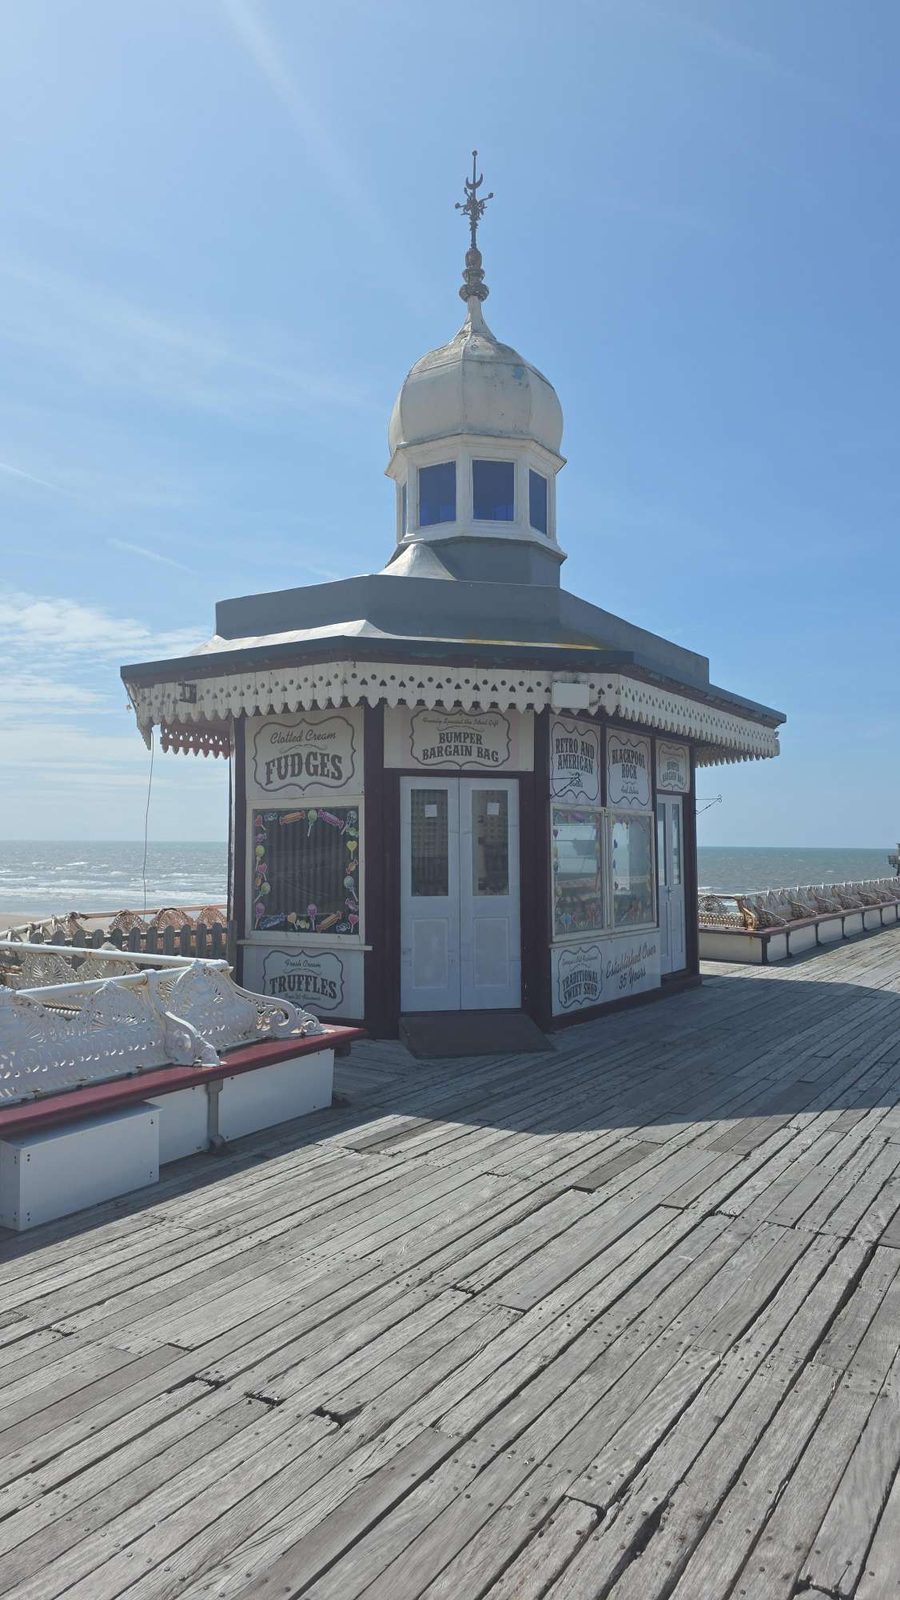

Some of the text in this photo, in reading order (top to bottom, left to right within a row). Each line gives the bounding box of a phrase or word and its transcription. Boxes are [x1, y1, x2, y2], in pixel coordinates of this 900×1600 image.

[270, 729, 336, 744] Clotted Cream
[439, 732, 483, 745] BUMPER
[422, 745, 499, 762] BARGAIN BAG
[556, 738, 594, 760] RETRO AND
[611, 748, 646, 769] BLACKPOOL
[265, 751, 343, 786] FUDGES
[558, 753, 594, 775] AMERICAN
[621, 764, 637, 780] ROCK
[269, 974, 337, 999] TRUFFLES
[562, 970, 598, 992] TRADITIONAL
[563, 982, 598, 1005] SWEET SHOP
